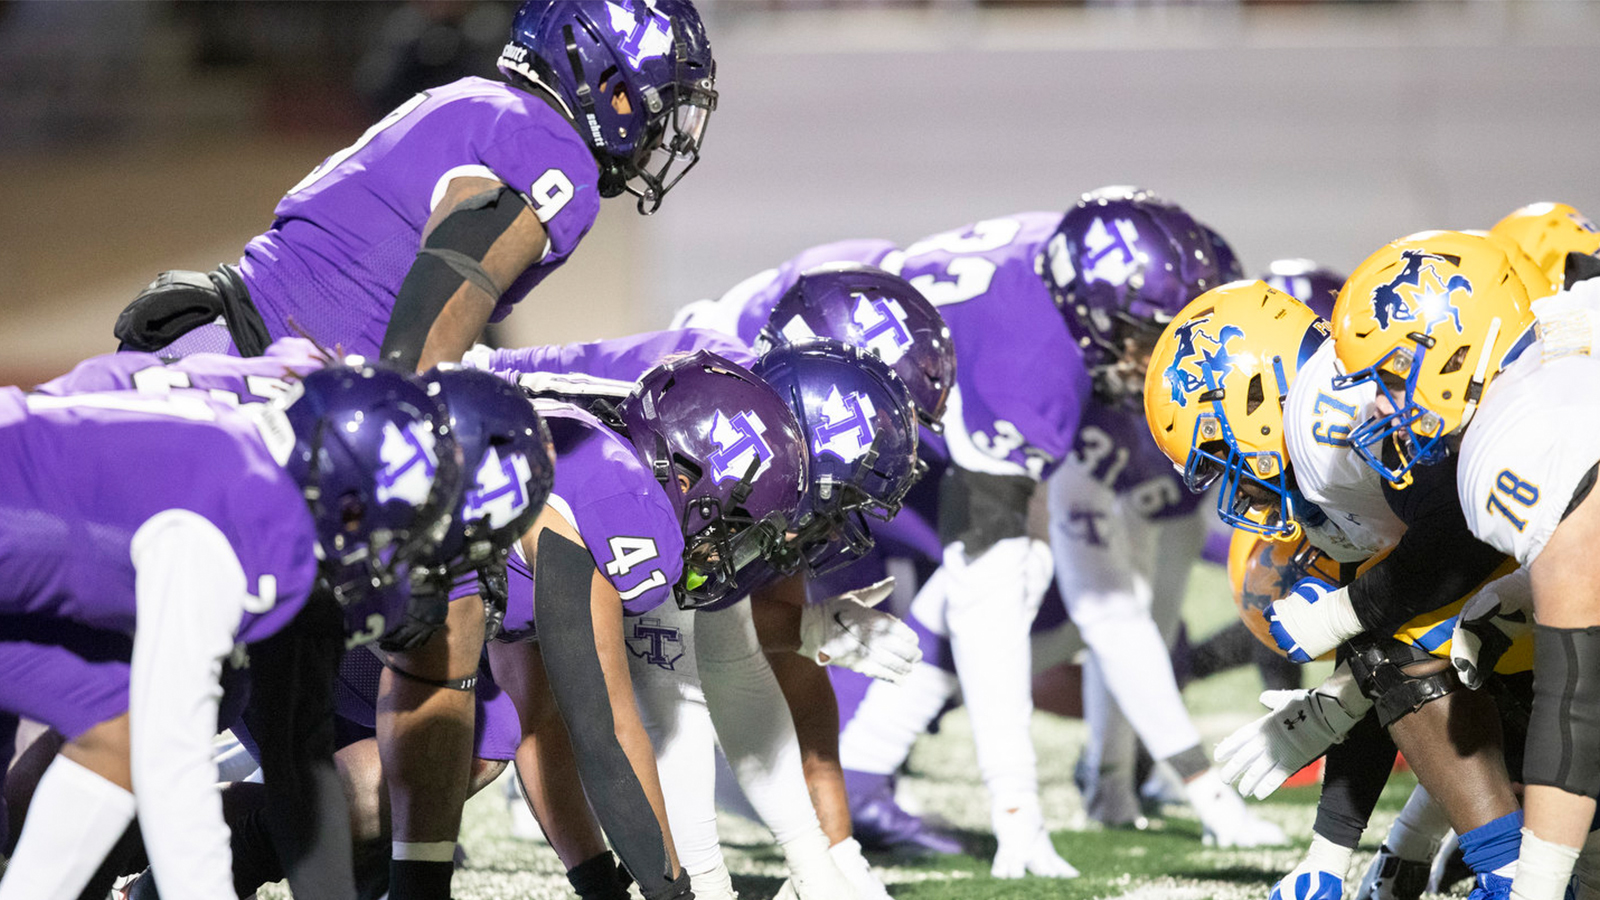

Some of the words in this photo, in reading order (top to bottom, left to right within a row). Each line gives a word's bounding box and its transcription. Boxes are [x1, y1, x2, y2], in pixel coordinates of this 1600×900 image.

[586, 112, 605, 147] schutt
[530, 168, 575, 223] 9
[1311, 388, 1359, 449] 67
[1486, 468, 1541, 533] 78
[604, 535, 668, 601] 41
